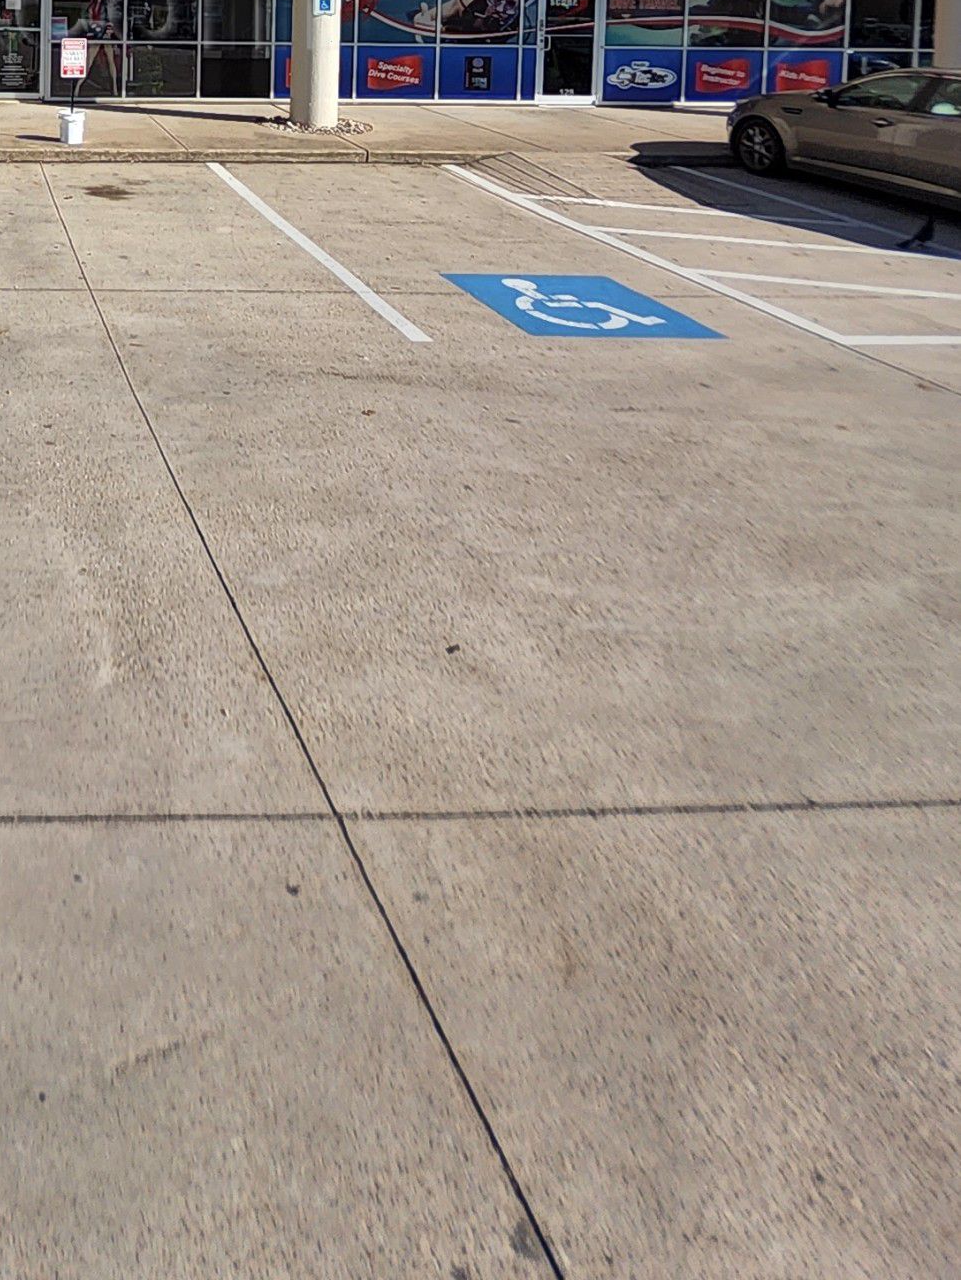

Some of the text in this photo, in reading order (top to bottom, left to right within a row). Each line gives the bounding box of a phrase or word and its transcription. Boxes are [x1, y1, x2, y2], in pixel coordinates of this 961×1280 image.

[378, 61, 414, 75] Specialty
[701, 64, 735, 76] Beginner
[368, 69, 419, 84] Dive Courses
